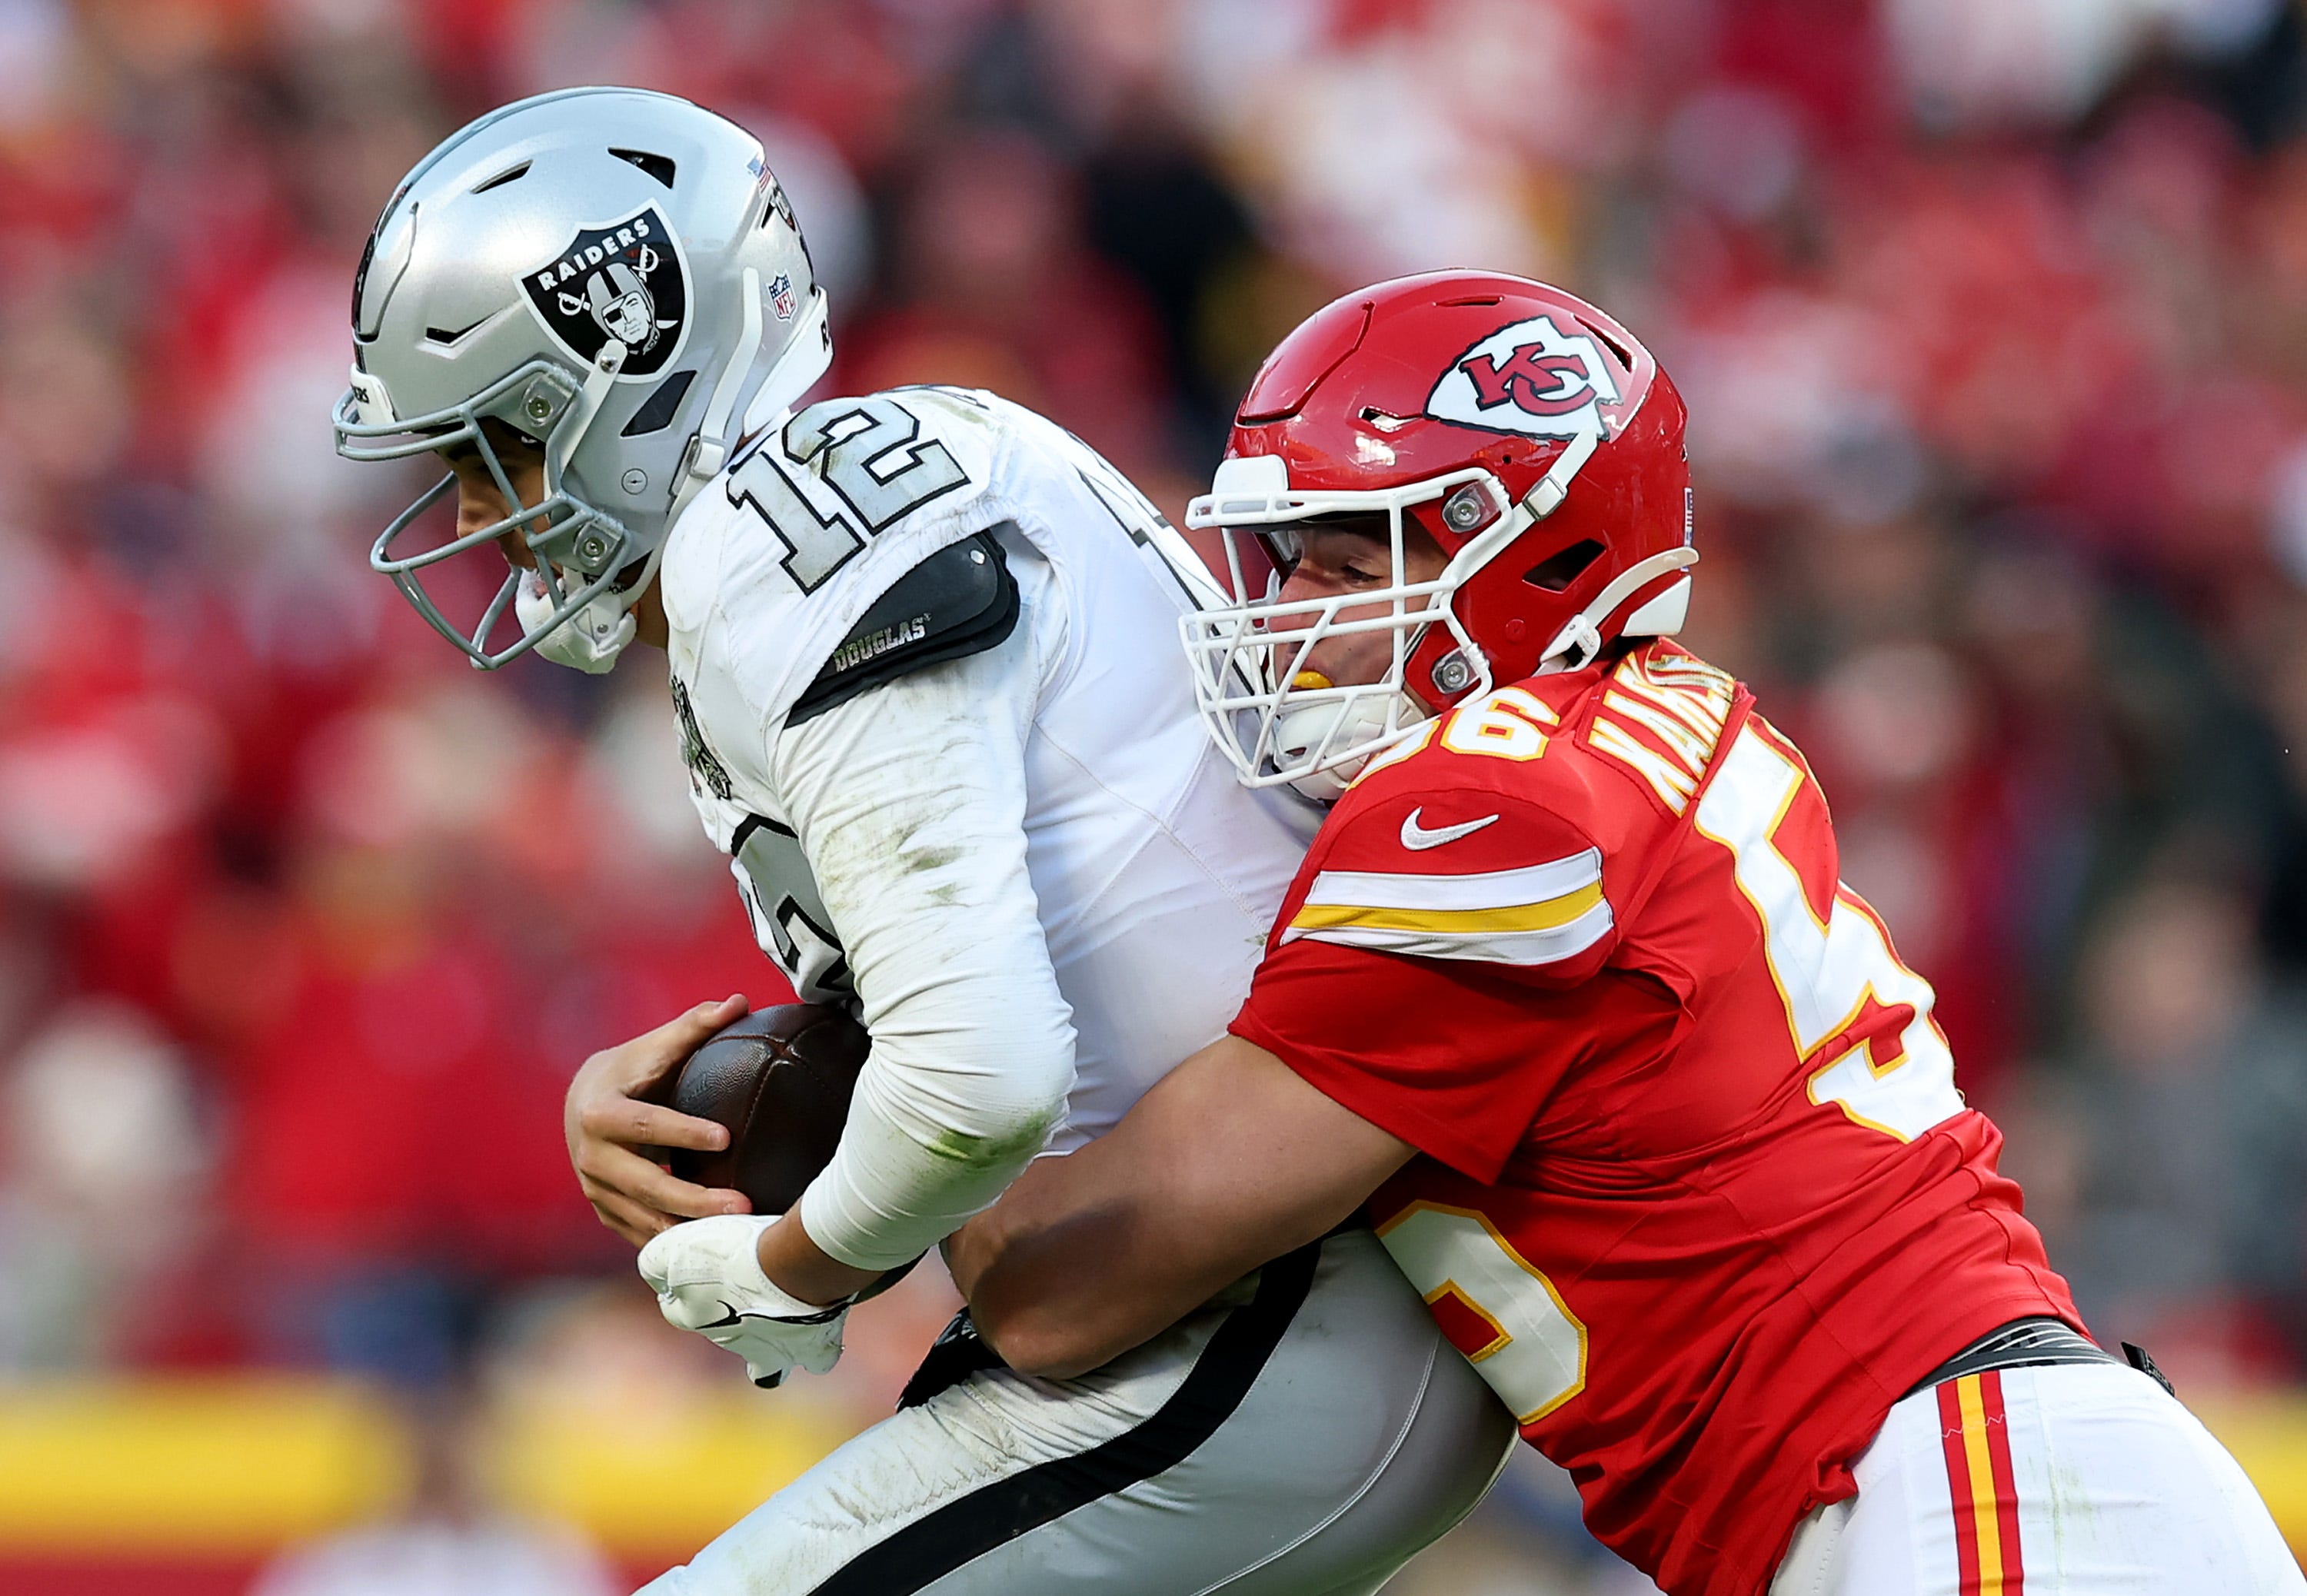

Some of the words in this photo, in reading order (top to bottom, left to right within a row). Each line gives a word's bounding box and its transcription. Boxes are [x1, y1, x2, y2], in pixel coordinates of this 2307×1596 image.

[538, 218, 650, 291] RAIDERS
[775, 291, 796, 316] NFL
[1459, 342, 1598, 417] KC
[726, 397, 972, 597] 12
[833, 617, 926, 672] DOUGLAS
